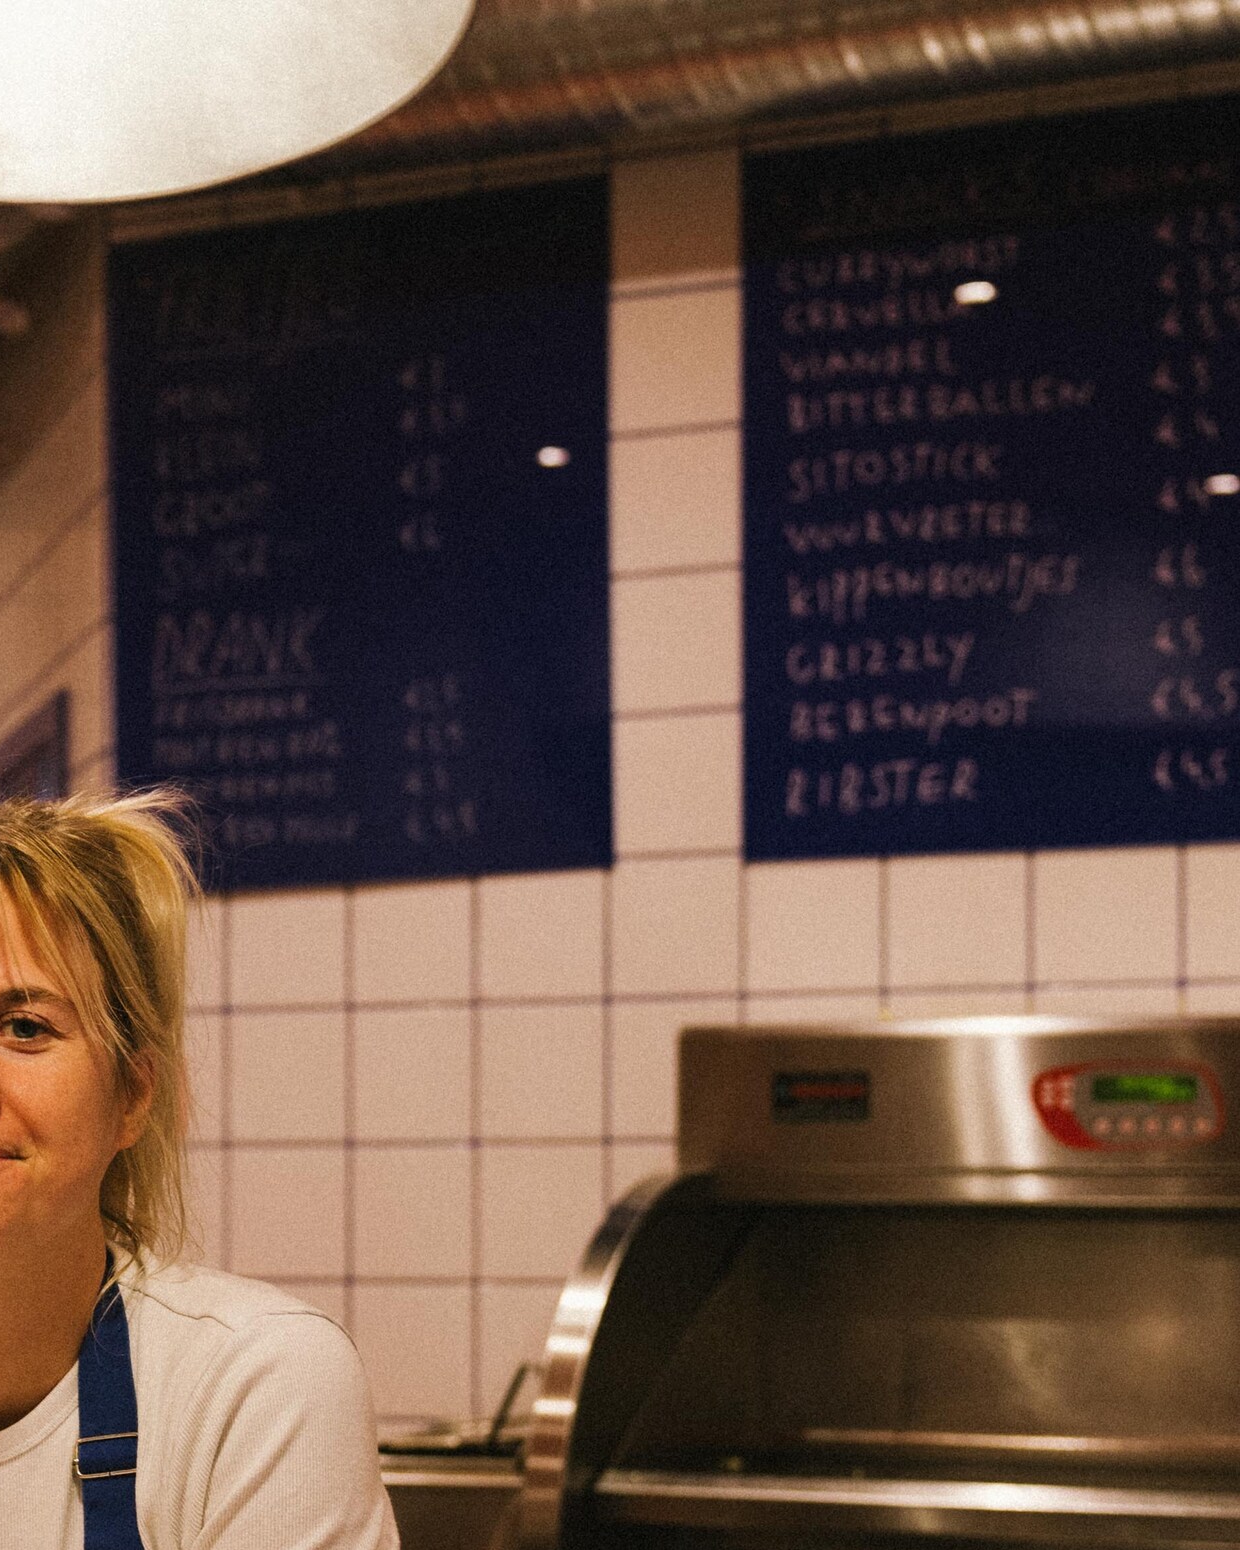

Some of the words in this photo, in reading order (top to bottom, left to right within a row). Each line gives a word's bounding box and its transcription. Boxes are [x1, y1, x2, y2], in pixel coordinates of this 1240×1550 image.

[786, 375, 1096, 434] BITTERBALLEN
[786, 442, 1005, 503] SITOSTICK
[786, 551, 1084, 626] KIPPENBOUTJES
[785, 630, 977, 687] GRIZZLY
[788, 686, 1039, 748] BERENPOOT
[783, 756, 980, 819] RIBSTER
